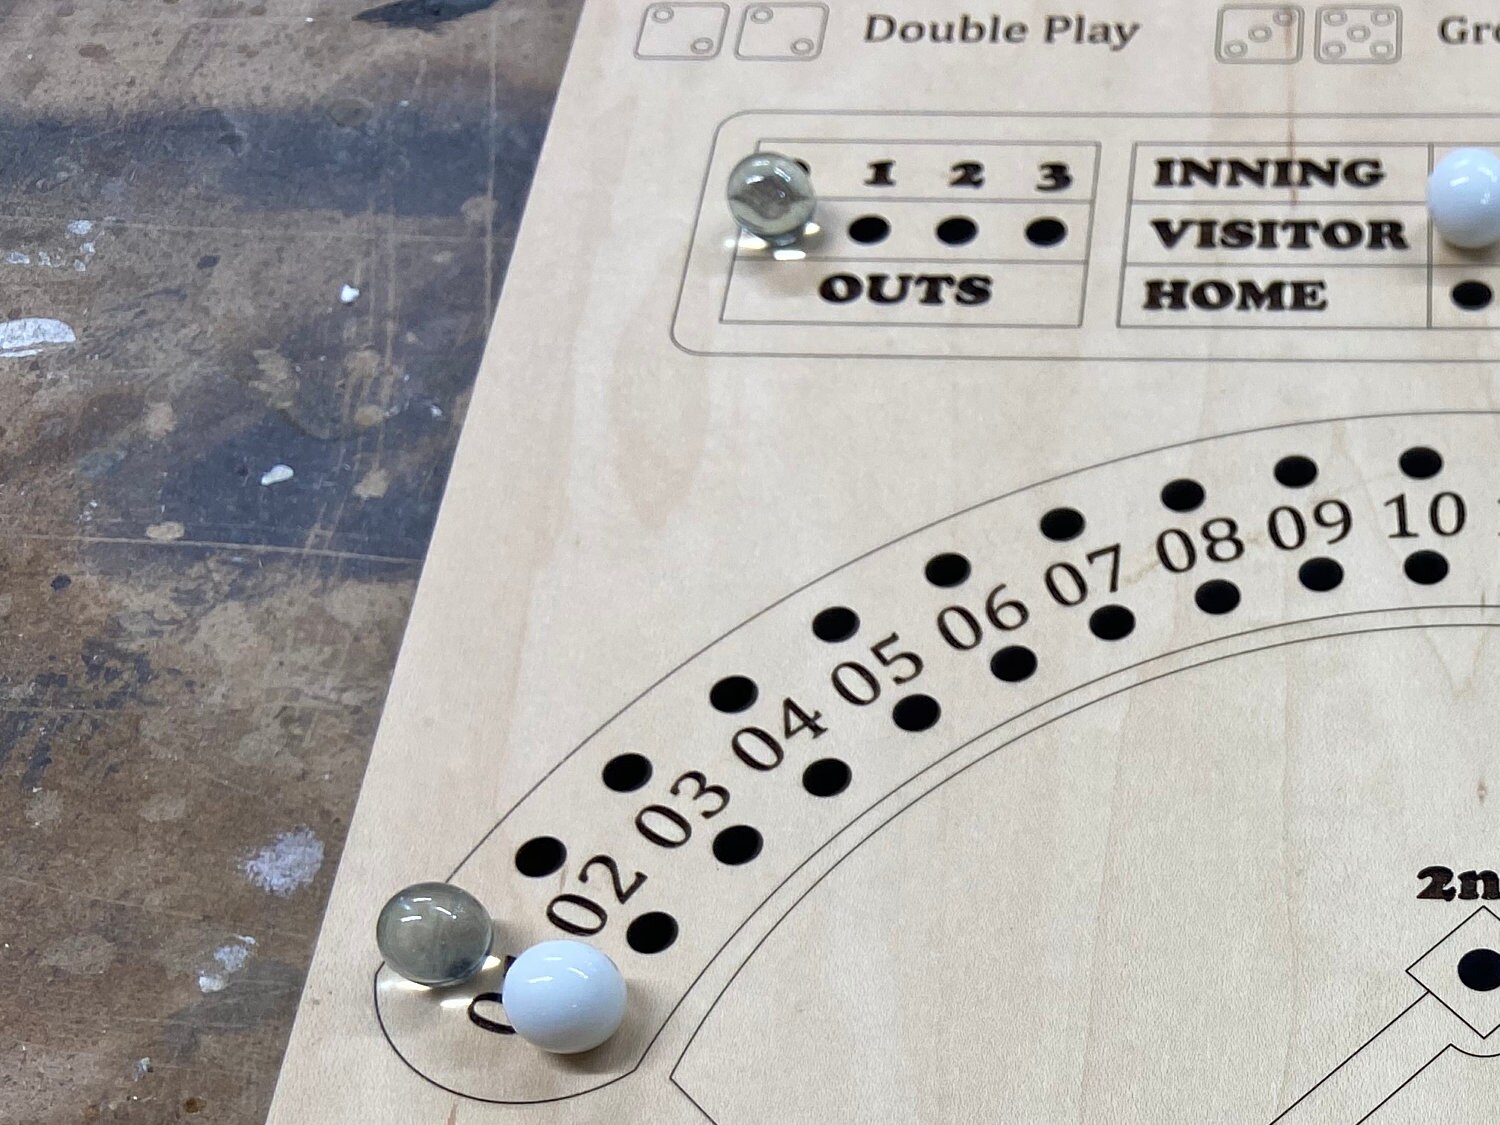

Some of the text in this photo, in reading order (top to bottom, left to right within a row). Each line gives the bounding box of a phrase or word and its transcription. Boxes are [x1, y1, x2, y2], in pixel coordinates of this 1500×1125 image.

[864, 13, 1140, 52] Double Play
[864, 159, 1073, 193] 1 2 3
[1154, 157, 1386, 189] INNING
[1150, 218, 1410, 251] VISITOR
[817, 272, 993, 306] OUTS
[1142, 278, 1328, 312] HOME
[545, 854, 648, 937] 02
[634, 770, 731, 849] 03
[731, 697, 829, 772] 04
[830, 631, 924, 707] 05
[936, 583, 1030, 651] 06
[1044, 543, 1121, 608] 07
[1155, 517, 1245, 574] 08
[1267, 499, 1353, 552] 09
[1384, 491, 1467, 539] 10
